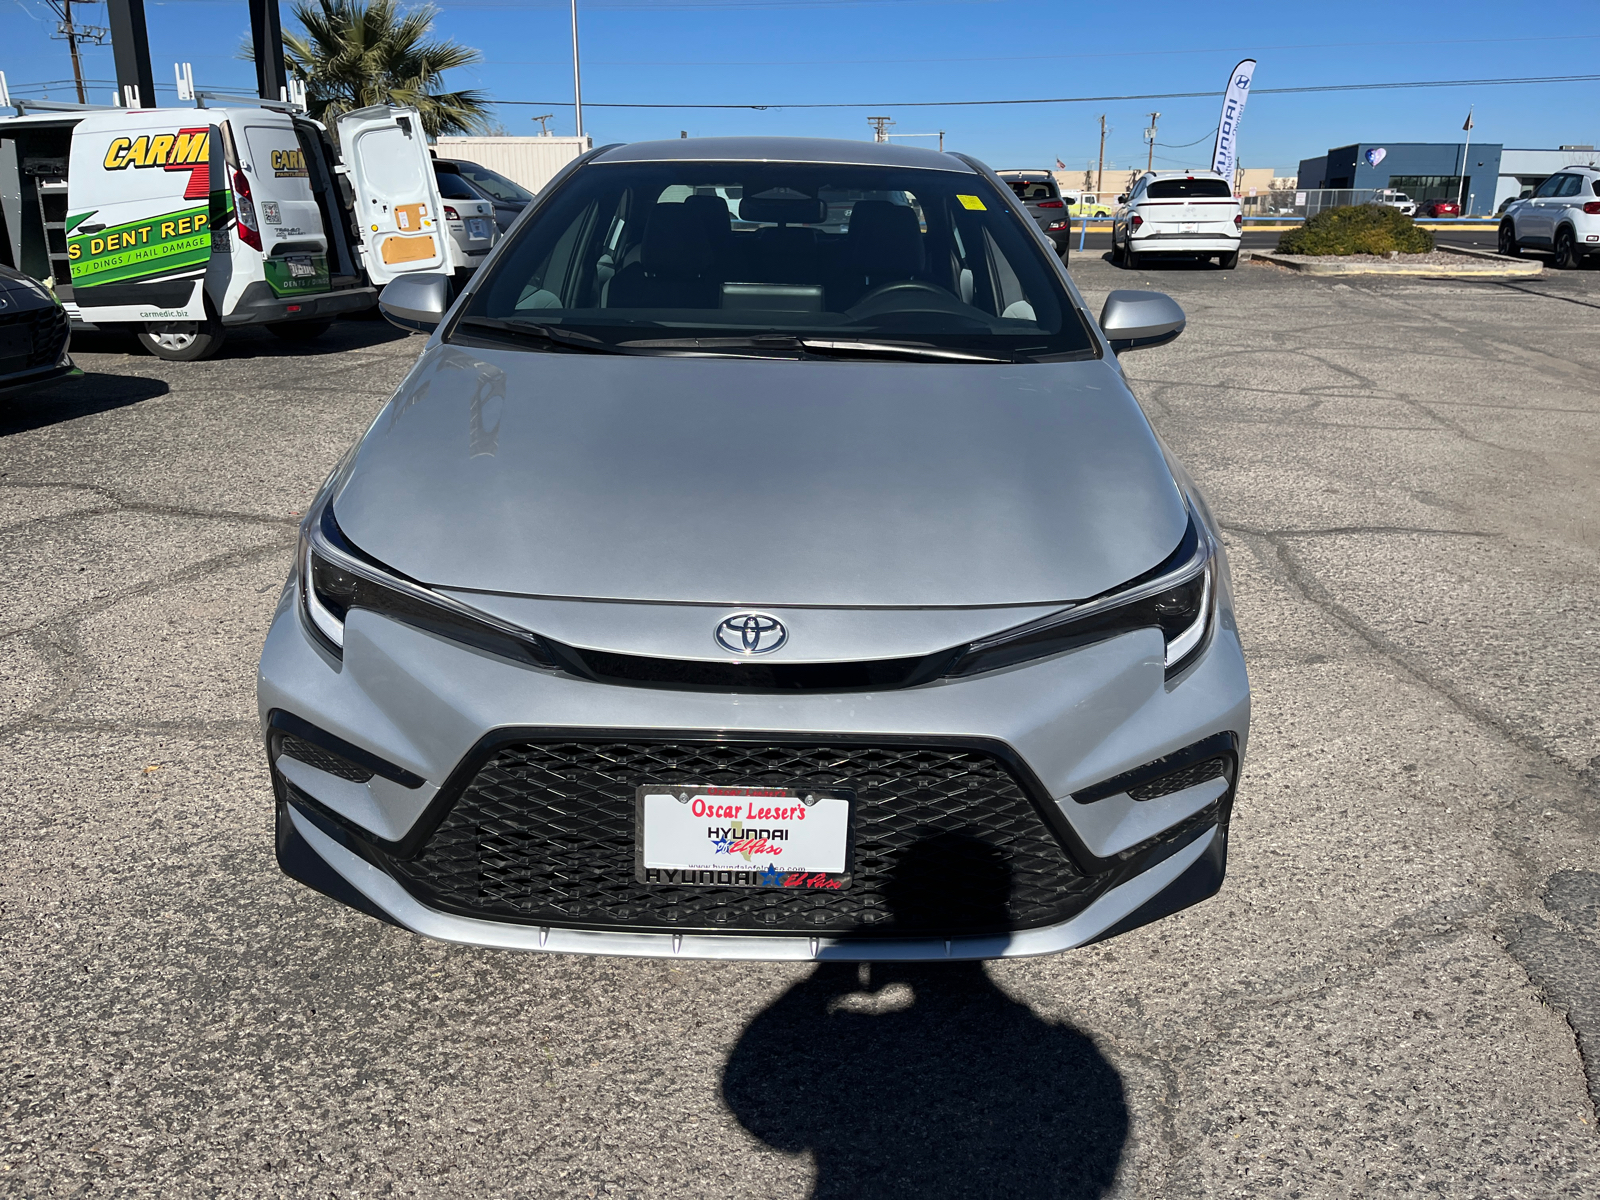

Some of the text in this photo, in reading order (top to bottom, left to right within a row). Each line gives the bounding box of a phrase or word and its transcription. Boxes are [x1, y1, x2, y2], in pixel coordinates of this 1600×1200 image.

[90, 226, 153, 255] DENT
[161, 214, 210, 239] REP
[93, 256, 123, 270] DINGS
[135, 248, 158, 260] HAIL
[162, 237, 205, 254] DAMAGE
[140, 310, 189, 318] carmedic.biz
[691, 799, 806, 821] Oscar Leeser's
[707, 826, 789, 841] HYUNDAI
[717, 840, 731, 854] of
[748, 838, 783, 855] Paso
[645, 868, 757, 886] HYUNDAI
[806, 872, 842, 889] Paso
